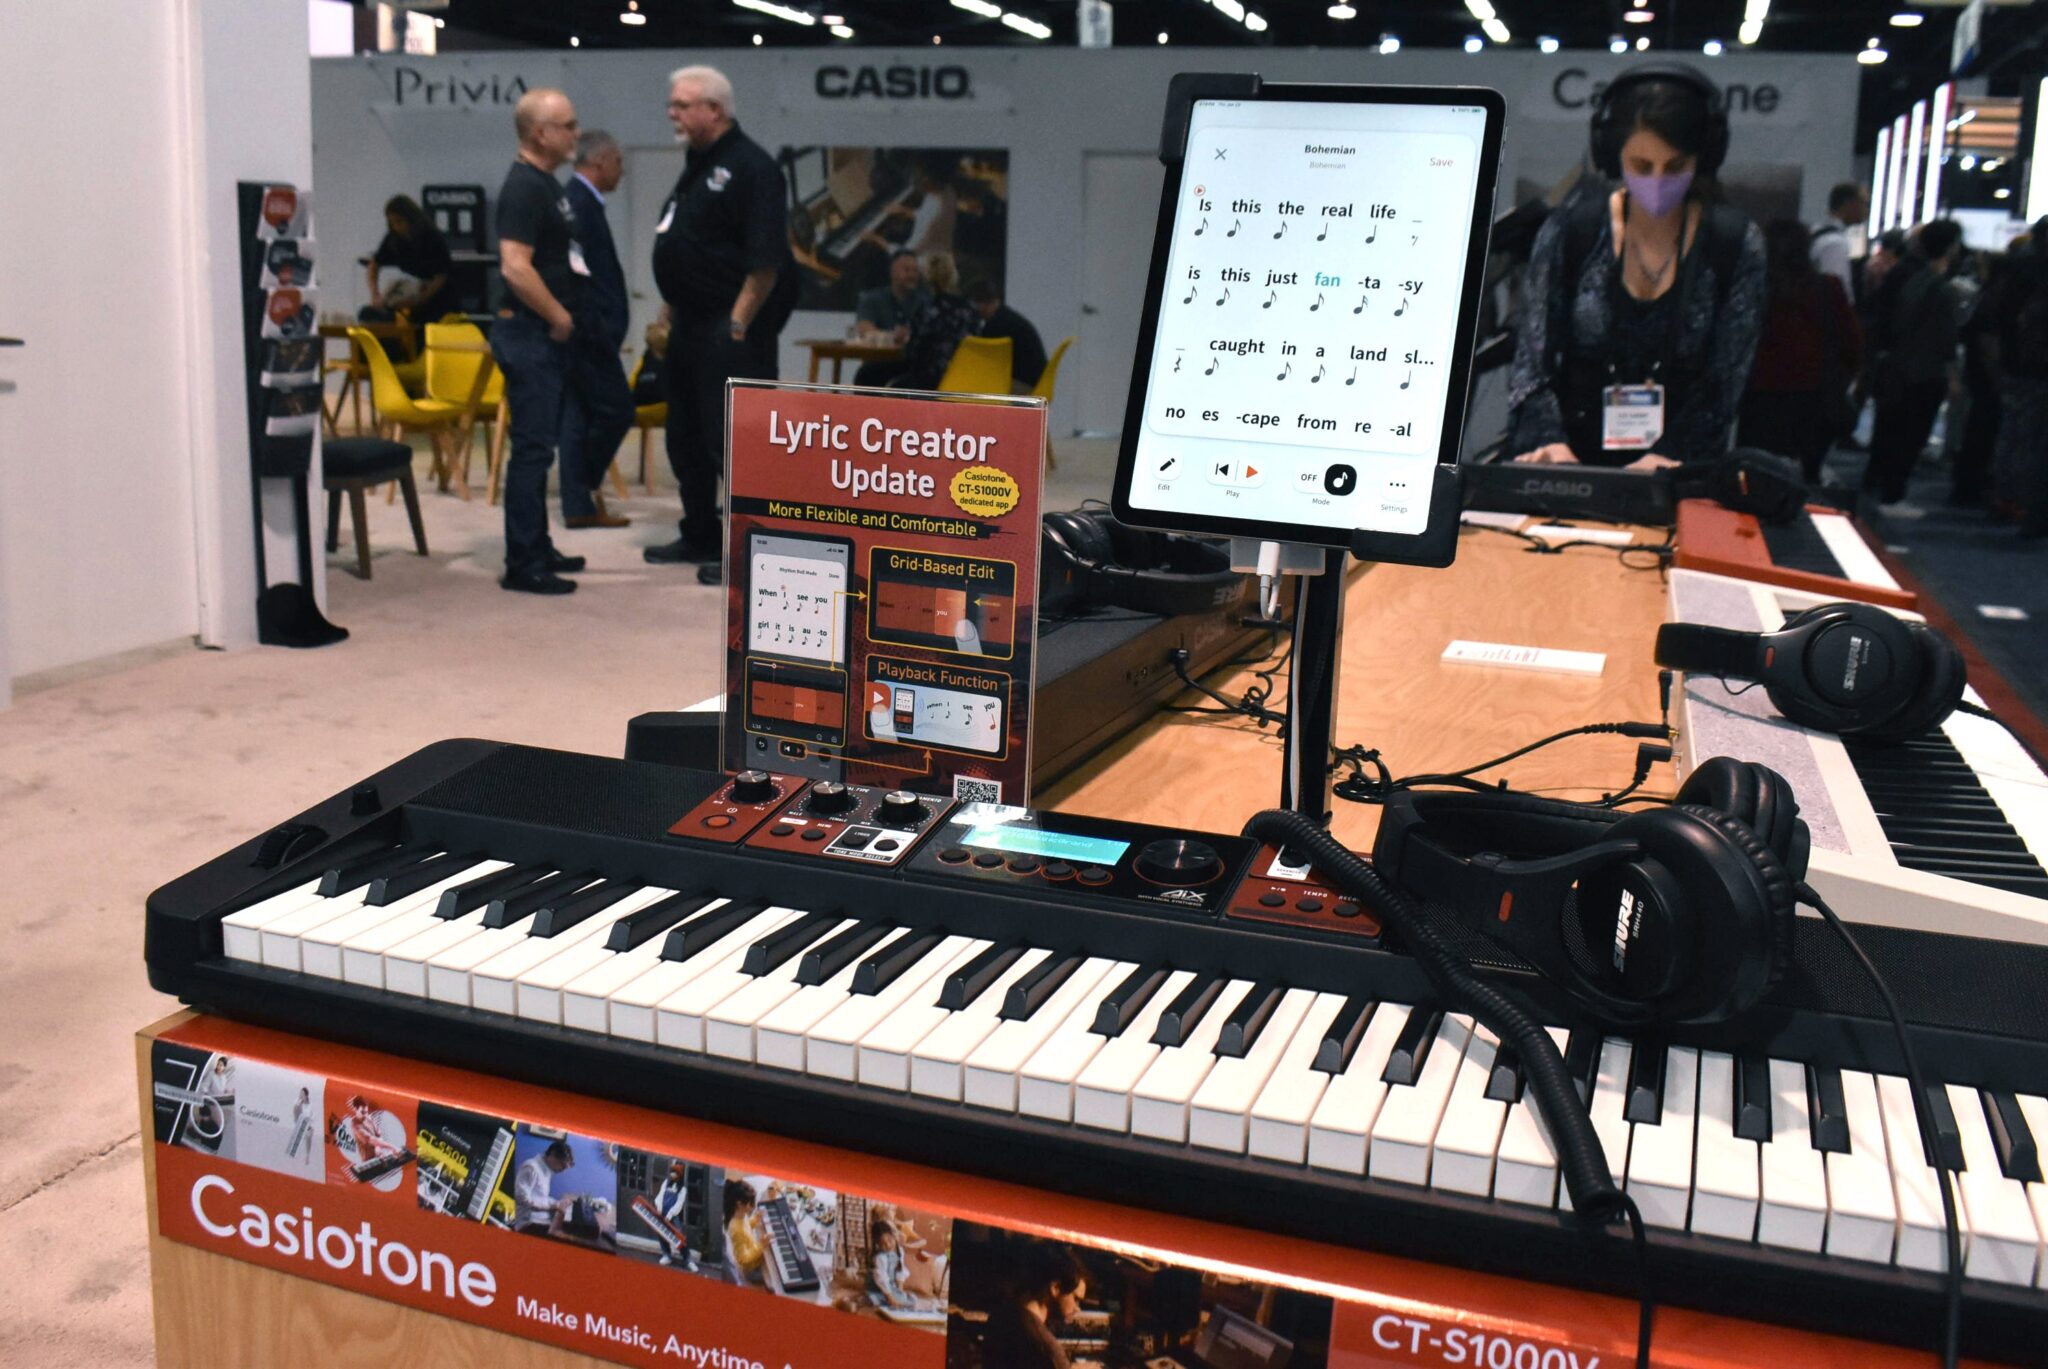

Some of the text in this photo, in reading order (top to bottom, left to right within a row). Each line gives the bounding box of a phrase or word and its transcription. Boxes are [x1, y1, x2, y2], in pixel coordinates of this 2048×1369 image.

[814, 65, 970, 98] CASIO
[1304, 144, 1356, 156] Bohemian
[1309, 161, 1346, 170] Bohemian
[1429, 157, 1454, 167] Save
[1199, 198, 1396, 220] Is this the real life
[1188, 266, 1423, 294] is this just fan -ta -sy
[1209, 338, 1266, 357] caught
[1281, 341, 1297, 355] in
[1315, 346, 1325, 358] a
[1349, 345, 1387, 362] land
[1165, 407, 1412, 437] no es -cape from re -al
[769, 410, 998, 462] Lyric Creator
[831, 459, 936, 498] Update
[964, 471, 1006, 483] Casiotone
[1301, 473, 1318, 482] OFF
[958, 483, 1012, 497] CT-S1000V
[1157, 483, 1170, 491] Edit
[1226, 489, 1240, 498] Play
[1524, 479, 1593, 498] CASIO
[959, 497, 1009, 509] dedicated app
[1311, 497, 1331, 506] Mode
[1380, 503, 1408, 514] Settings
[769, 502, 977, 536] More Flexible and Comfortable
[889, 555, 996, 580] Grid-Based Edit
[758, 588, 778, 597] When
[815, 596, 828, 604] you
[936, 609, 948, 617] you
[757, 621, 769, 630] girl
[775, 622, 781, 630] it
[788, 624, 795, 632] is
[877, 661, 999, 692] Playback Function
[984, 702, 996, 712] you
[1303, 890, 1328, 898] TEMPO
[1632, 900, 1645, 939] SRH440
[1613, 888, 1634, 973] SHURE
[419, 1128, 467, 1166] CT-S500
[191, 1174, 497, 1307] Casiotone
[516, 1295, 578, 1331] Make
[585, 1312, 657, 1354] Music,
